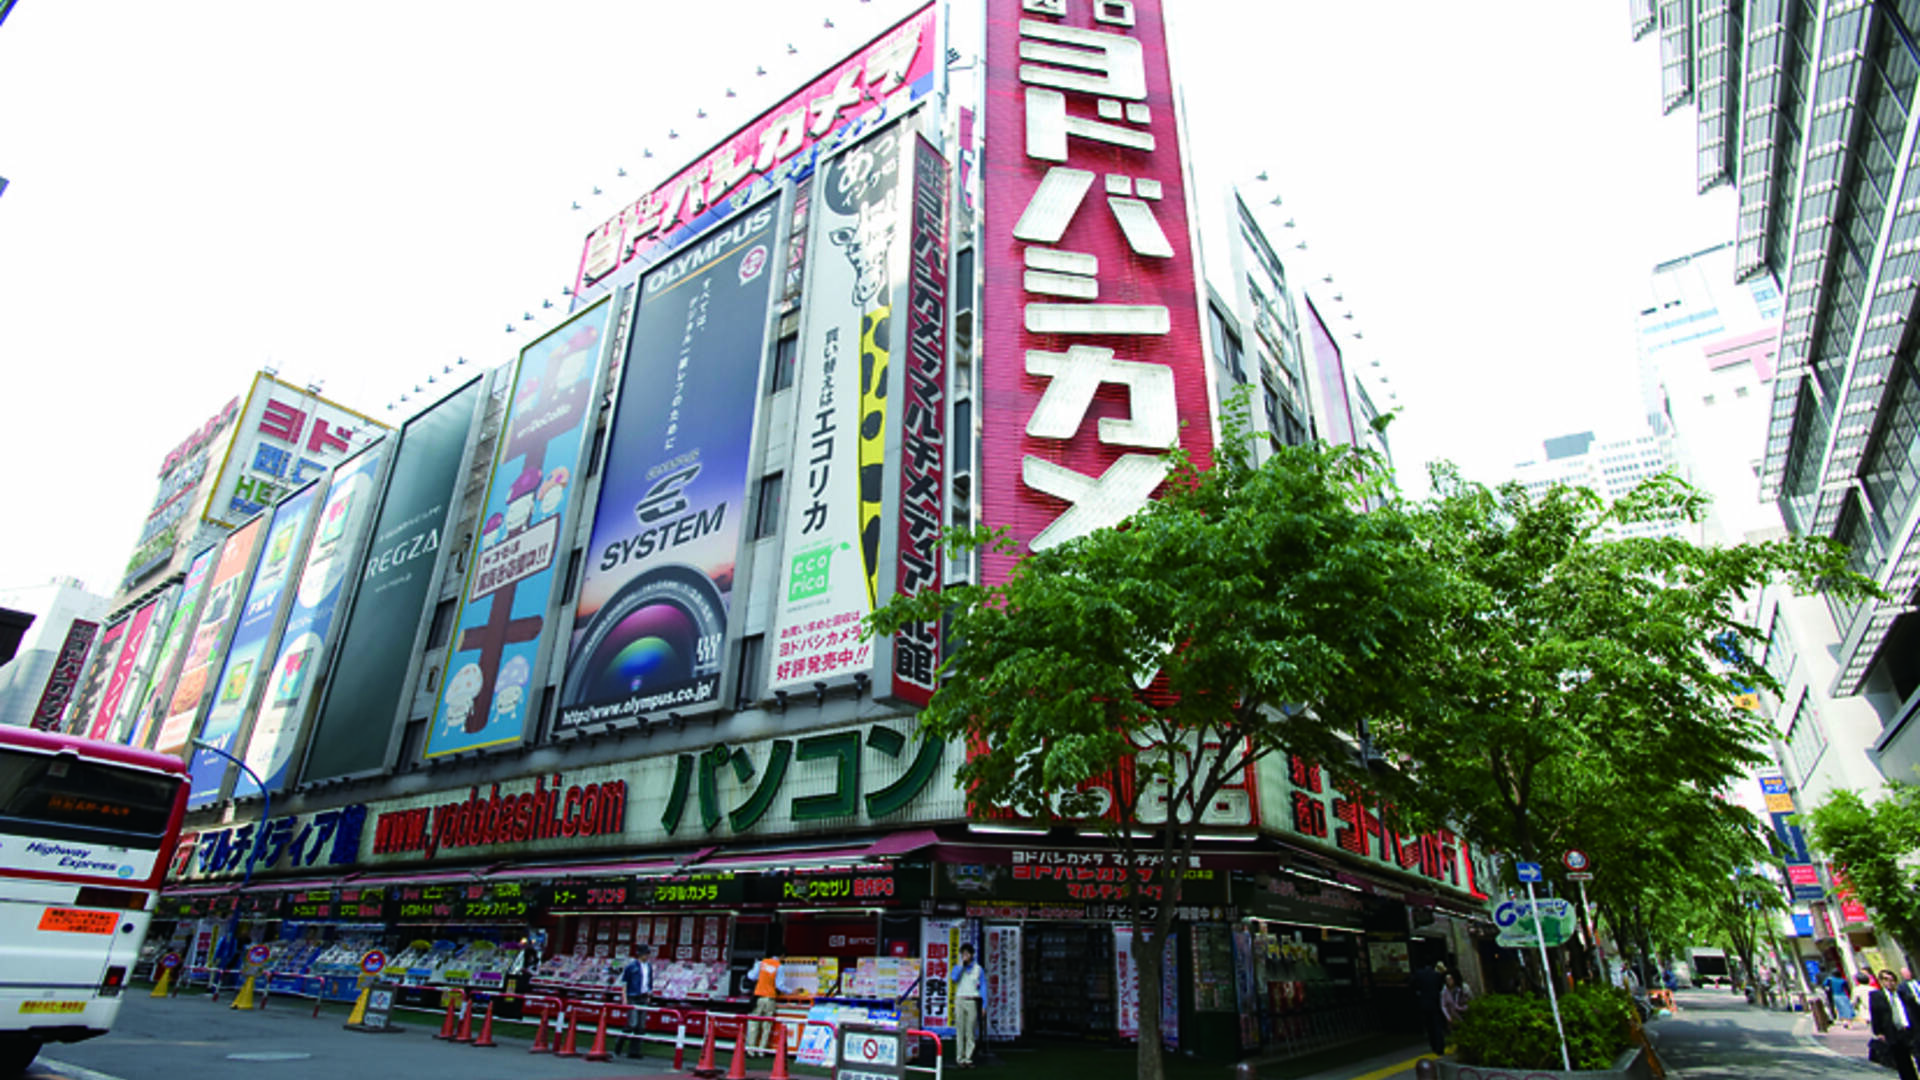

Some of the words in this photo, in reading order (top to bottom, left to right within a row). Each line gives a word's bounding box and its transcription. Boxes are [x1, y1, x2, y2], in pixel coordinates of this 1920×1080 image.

[584, 24, 924, 286] ヨドバシカメラ
[647, 207, 772, 293] OLYMPUS
[1012, 18, 1177, 690] ヨドバシカメ
[363, 528, 439, 582] REGZA
[600, 500, 727, 572] SYSTEM
[791, 574, 826, 595] rica
[793, 555, 827, 576] eco
[776, 644, 870, 681] 好評発売中!!
[779, 624, 862, 657] ヨドバシカメラ
[561, 680, 716, 726] http://www.olympus.co.jp/
[661, 724, 946, 836] パソコン
[372, 773, 626, 860] www.yodobashi.com
[26, 842, 92, 859] Highway
[58, 856, 118, 871] Express
[1011, 850, 1105, 866] ヨドバシカメラ
[924, 943, 949, 1016] 即時発行
